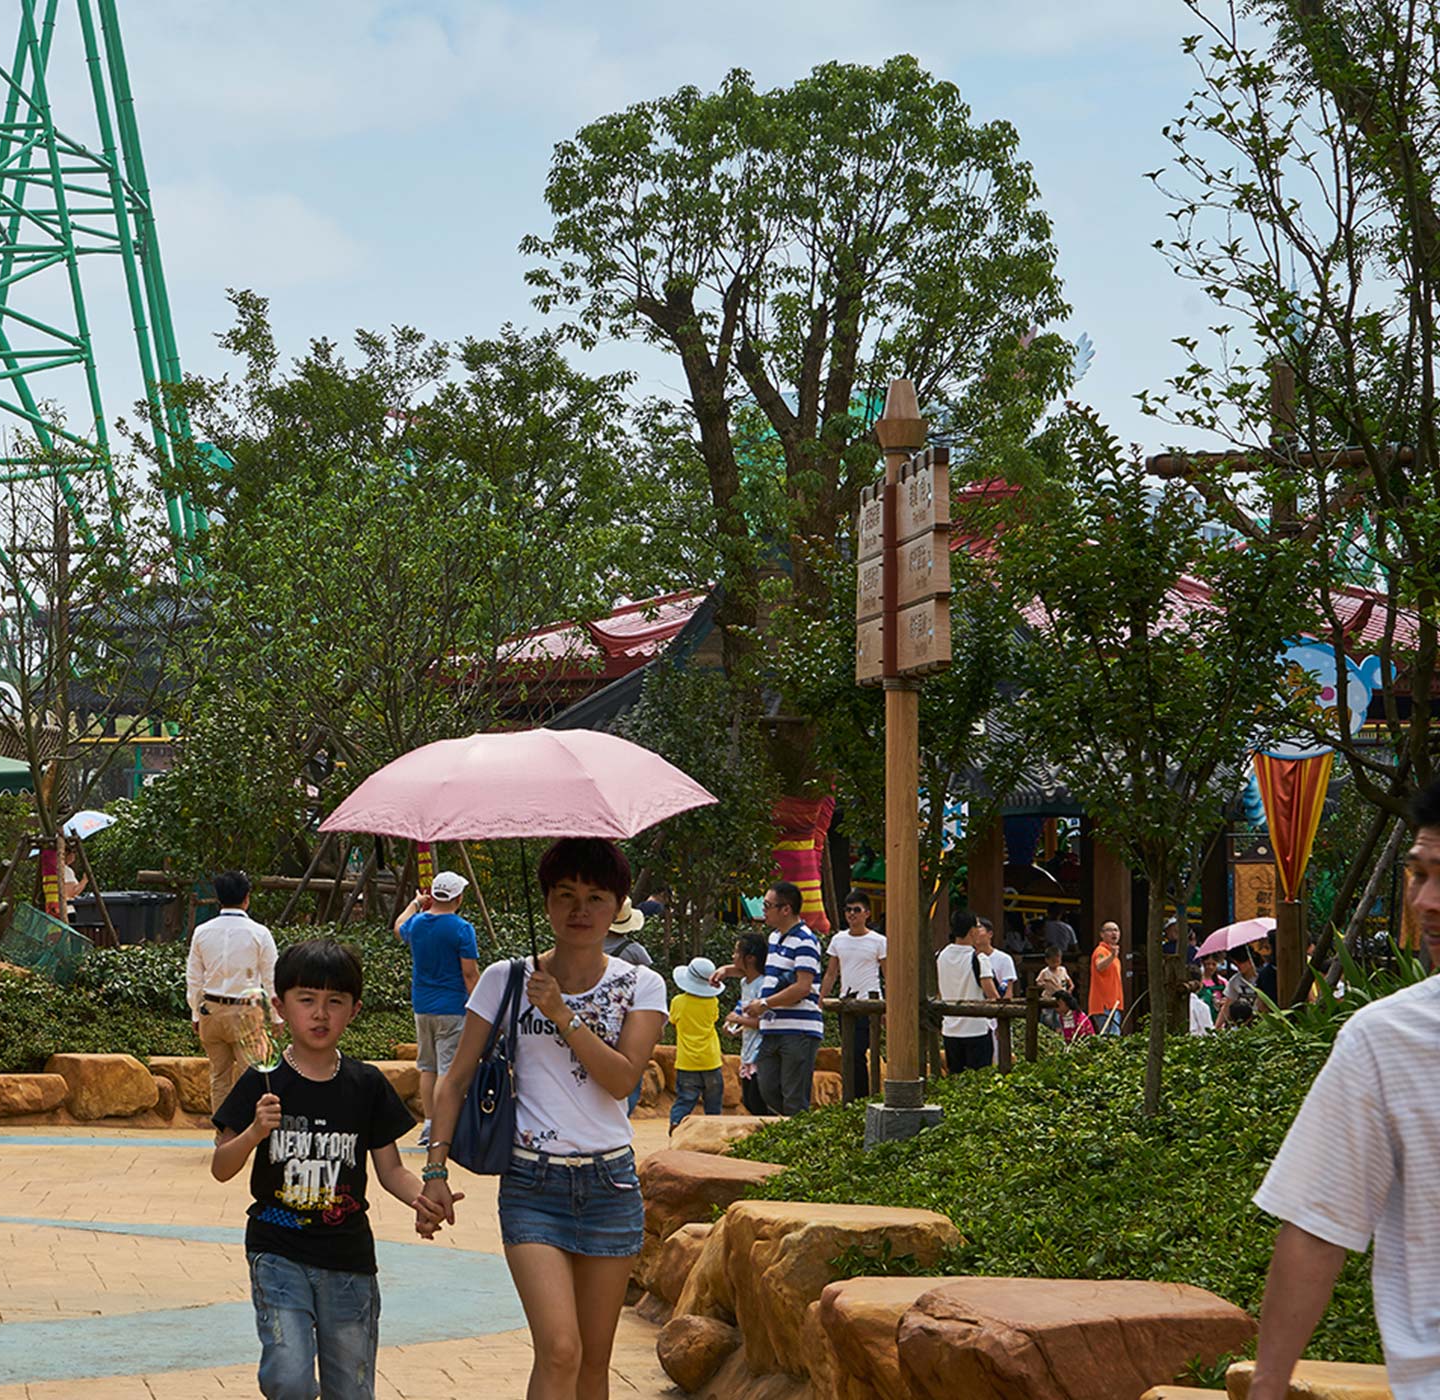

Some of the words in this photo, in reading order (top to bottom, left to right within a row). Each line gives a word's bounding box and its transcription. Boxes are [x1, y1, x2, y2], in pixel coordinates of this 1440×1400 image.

[269, 1129, 313, 1164] NEW
[314, 1132, 359, 1168] YORK
[284, 1159, 342, 1205] CITY
